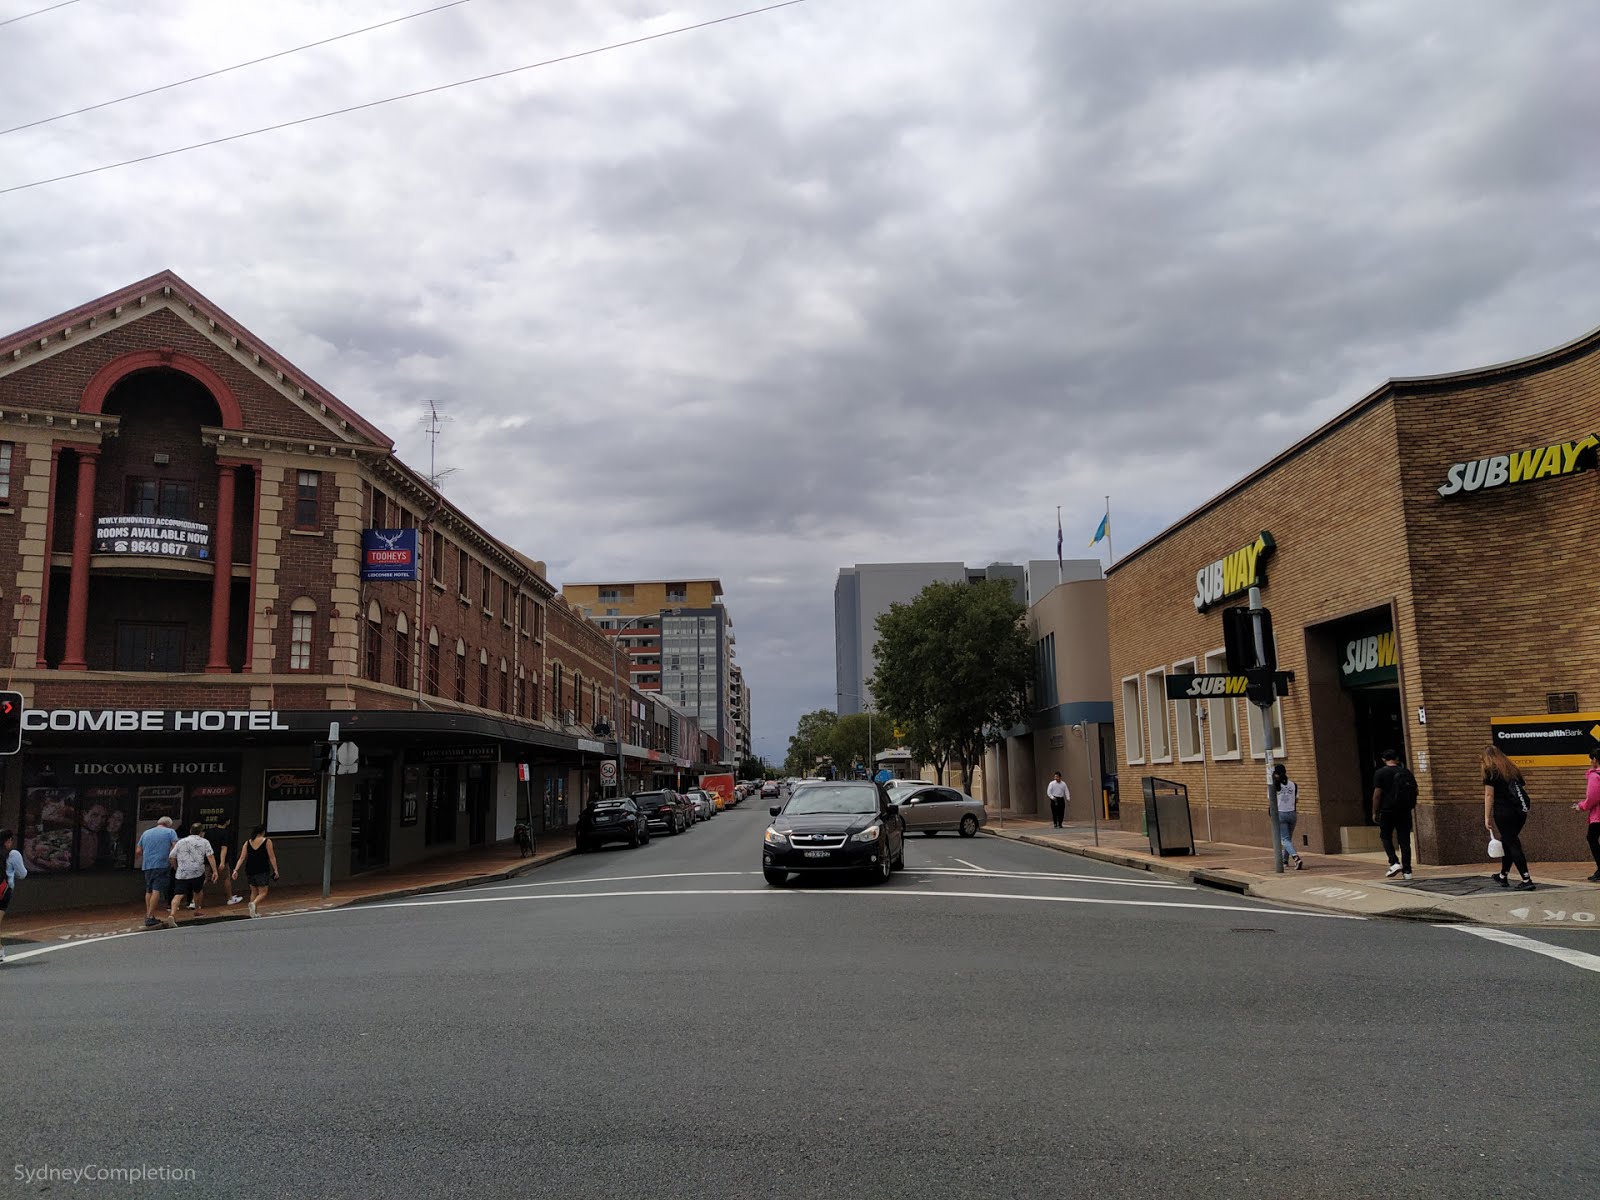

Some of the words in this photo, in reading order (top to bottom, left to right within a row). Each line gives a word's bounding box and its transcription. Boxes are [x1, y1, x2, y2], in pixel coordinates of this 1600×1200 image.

[1437, 435, 1600, 497] SUBWAY
[98, 516, 118, 525] NEWLY
[118, 516, 155, 525] RENOVATED
[156, 518, 208, 531] ACCOMMODATION
[97, 527, 129, 539] ROOMS
[130, 527, 186, 541] AVAILABLE
[187, 532, 209, 545] NOW
[131, 541, 160, 553] 9649
[161, 542, 188, 556] 8677
[371, 551, 407, 561] TOOHEYS
[1193, 534, 1266, 608] SUBWAY
[1342, 631, 1398, 675] SUBW
[1186, 676, 1248, 695] SUBW
[21, 709, 165, 731] COMBE
[174, 710, 290, 731] HOTEL
[73, 762, 164, 775] LIDCOMBE
[172, 761, 227, 774] HOTEL
[201, 787, 226, 795] ENJOY
